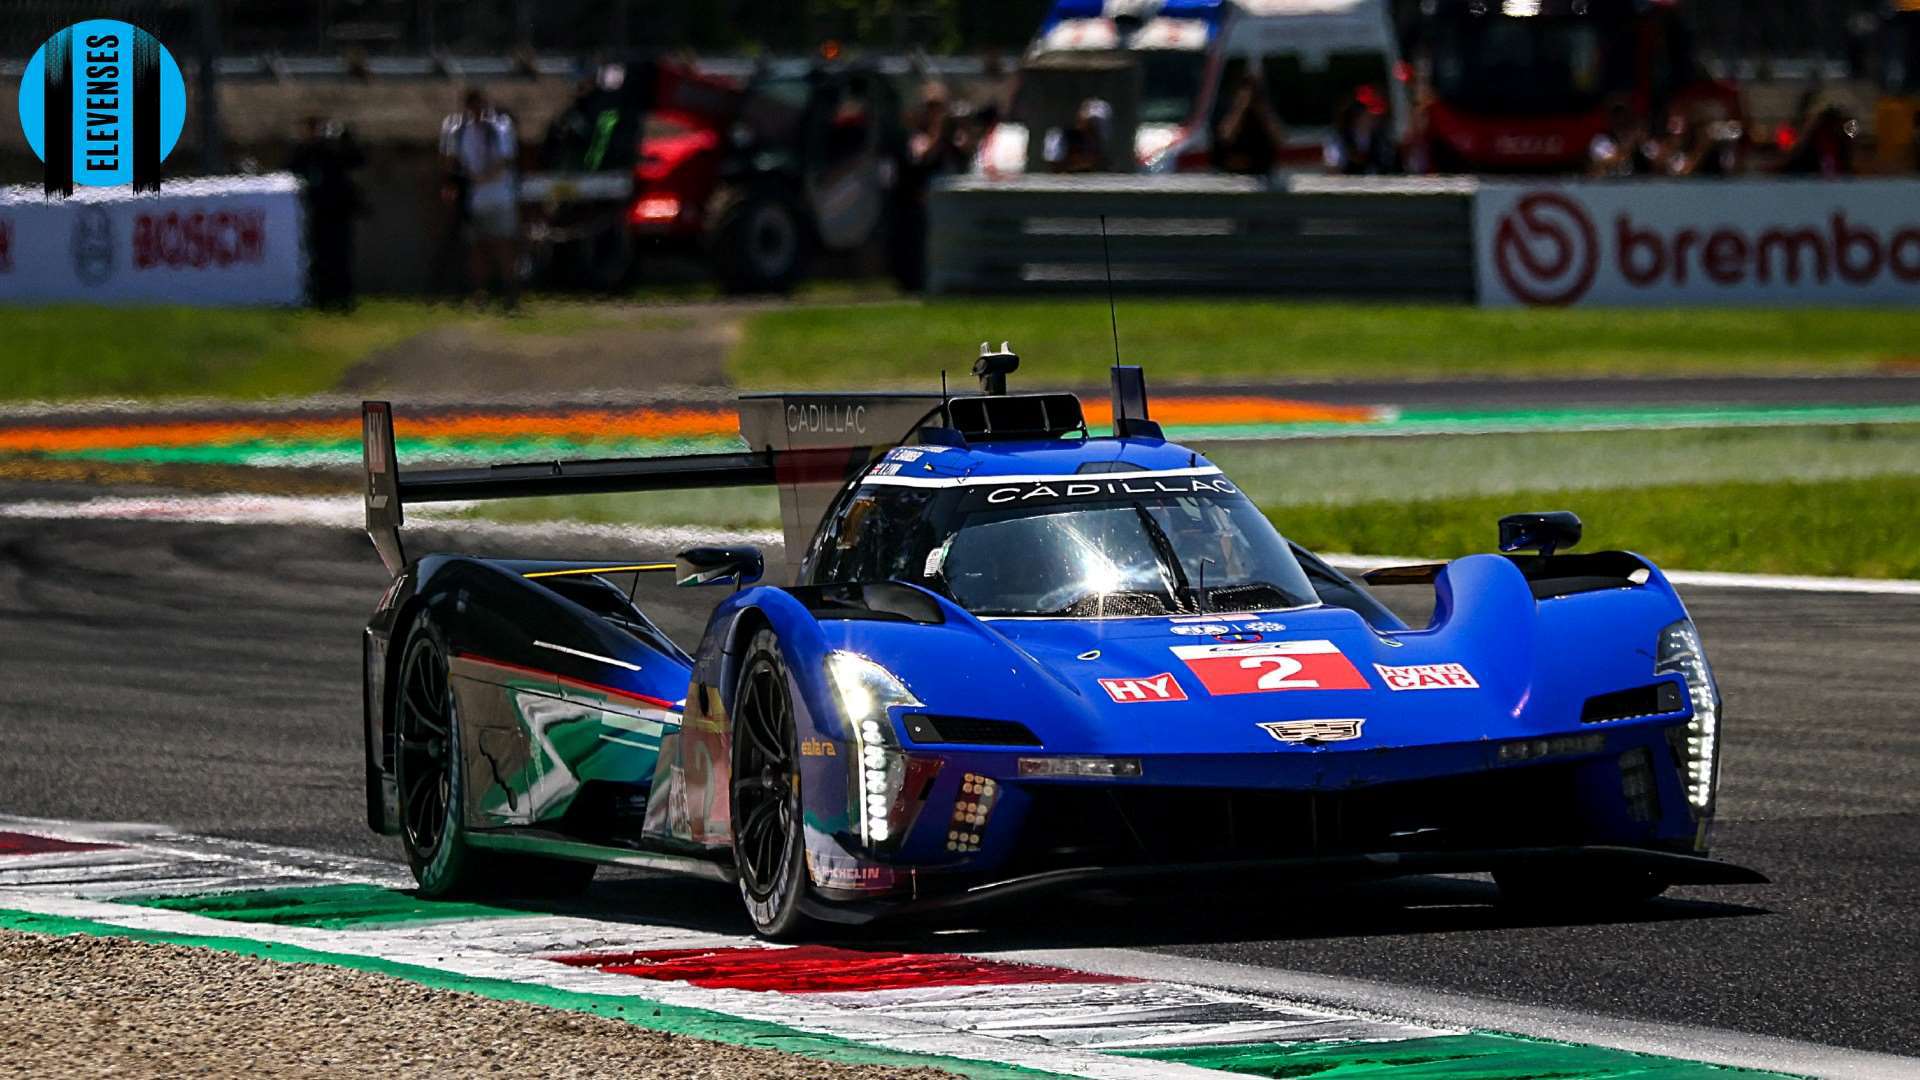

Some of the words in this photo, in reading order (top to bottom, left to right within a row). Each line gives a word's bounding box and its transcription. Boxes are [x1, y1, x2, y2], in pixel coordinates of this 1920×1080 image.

[132, 209, 265, 271] BOSCH
[1616, 212, 1920, 288] brembo
[787, 404, 866, 434] CADILLAC
[987, 479, 1236, 503] CADILLAC
[1239, 655, 1319, 690] 2
[1380, 665, 1461, 676] HYPER
[1387, 673, 1472, 688] CAR
[1108, 676, 1172, 701] HY
